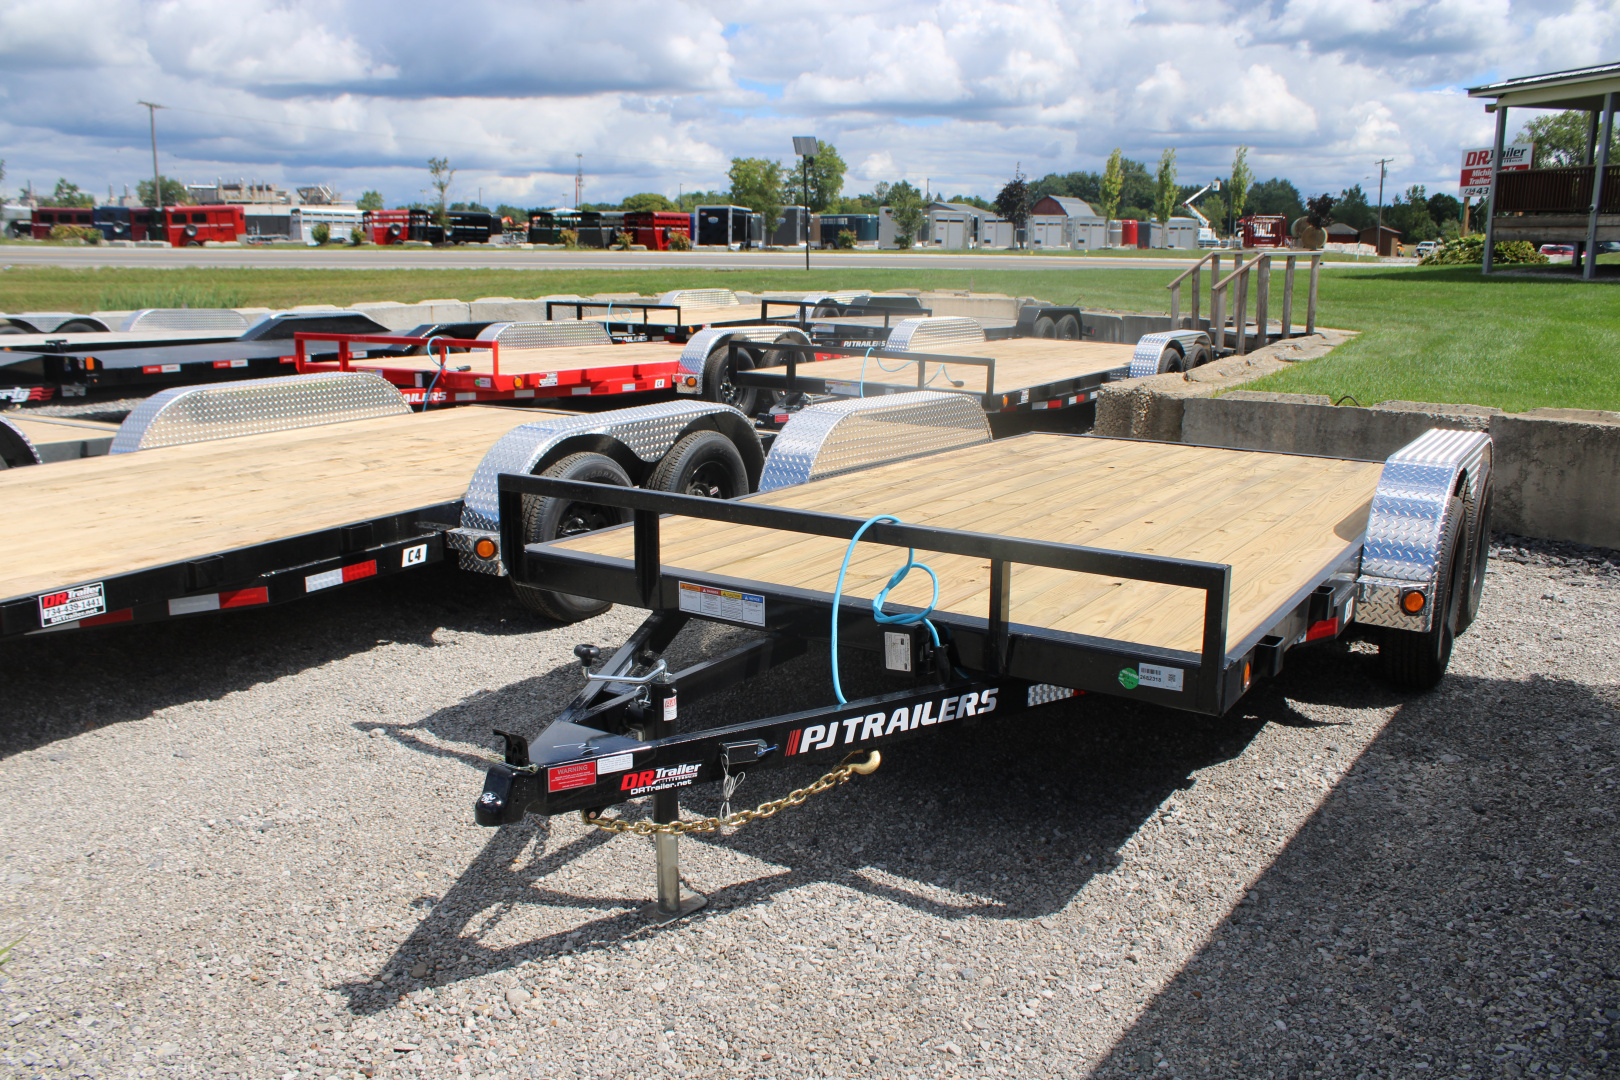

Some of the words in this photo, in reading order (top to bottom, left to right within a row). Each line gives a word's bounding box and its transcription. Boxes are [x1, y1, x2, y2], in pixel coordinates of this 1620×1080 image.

[1465, 150, 1489, 167] DR
[1490, 148, 1527, 159] Tiler
[1469, 178, 1491, 186] Trailer
[843, 340, 852, 348] PJ
[403, 391, 447, 403] AILERS
[407, 548, 421, 563] C4
[43, 592, 68, 608] DR
[67, 586, 101, 599] Trailer
[45, 598, 101, 617] 734-439-1441
[51, 607, 98, 623] DRTrailer.net
[799, 721, 839, 754] PJ
[842, 687, 999, 745] TRAILERS
[557, 764, 588, 775] WARNING
[620, 770, 655, 791] DR
[655, 763, 702, 779] Trailer
[630, 779, 692, 796] DRTrailer.net
